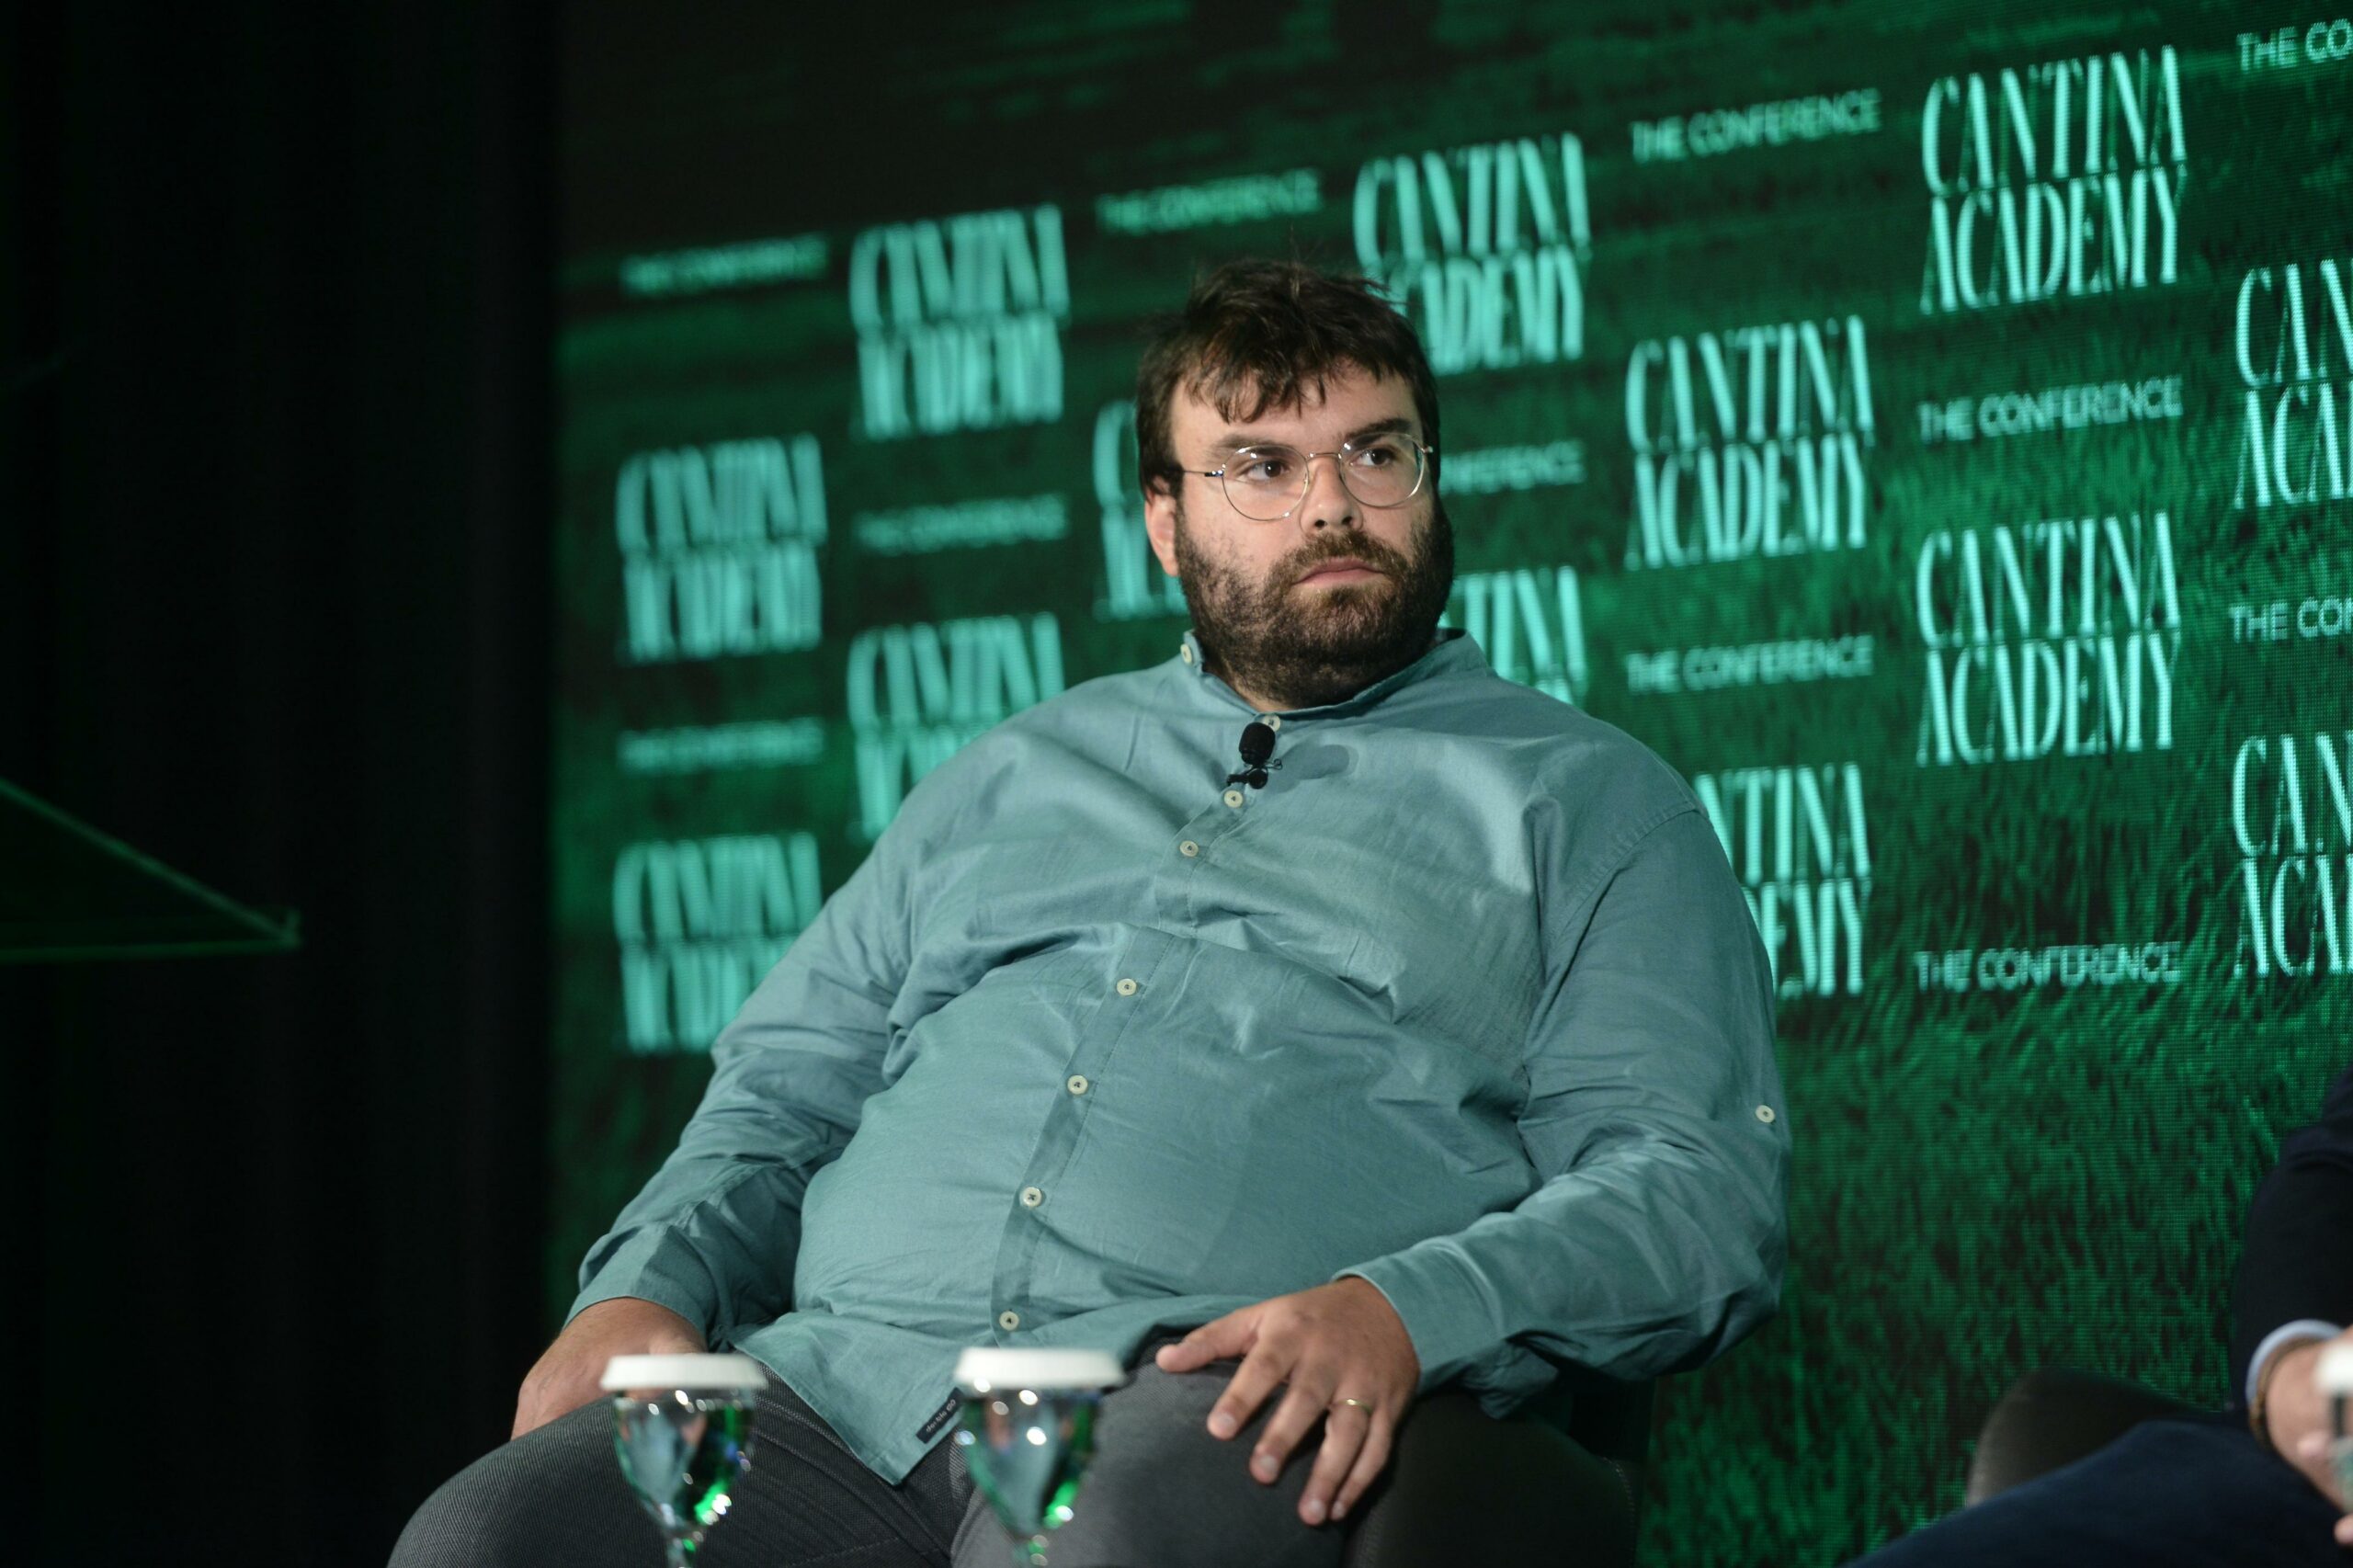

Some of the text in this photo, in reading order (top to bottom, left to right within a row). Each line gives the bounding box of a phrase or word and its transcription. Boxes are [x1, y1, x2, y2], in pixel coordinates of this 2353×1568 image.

[2236, 27, 2297, 70] THE
[1922, 44, 2186, 199] CANTINA
[1352, 131, 1590, 278] CANTINA
[1920, 164, 2188, 315] ACADEMY
[1625, 315, 1874, 455] CANTINA
[1919, 375, 2182, 443] THE CONFERENCE
[2234, 382, 2353, 509] ACA
[1625, 431, 1876, 571] ACADEMY
[1916, 510, 2181, 649] CANTINA
[2229, 600, 2288, 642] THE
[1916, 628, 2181, 767] ACADEMY
[1915, 941, 2181, 993] THE CONFERENCE
[2234, 855, 2353, 980] ACA
